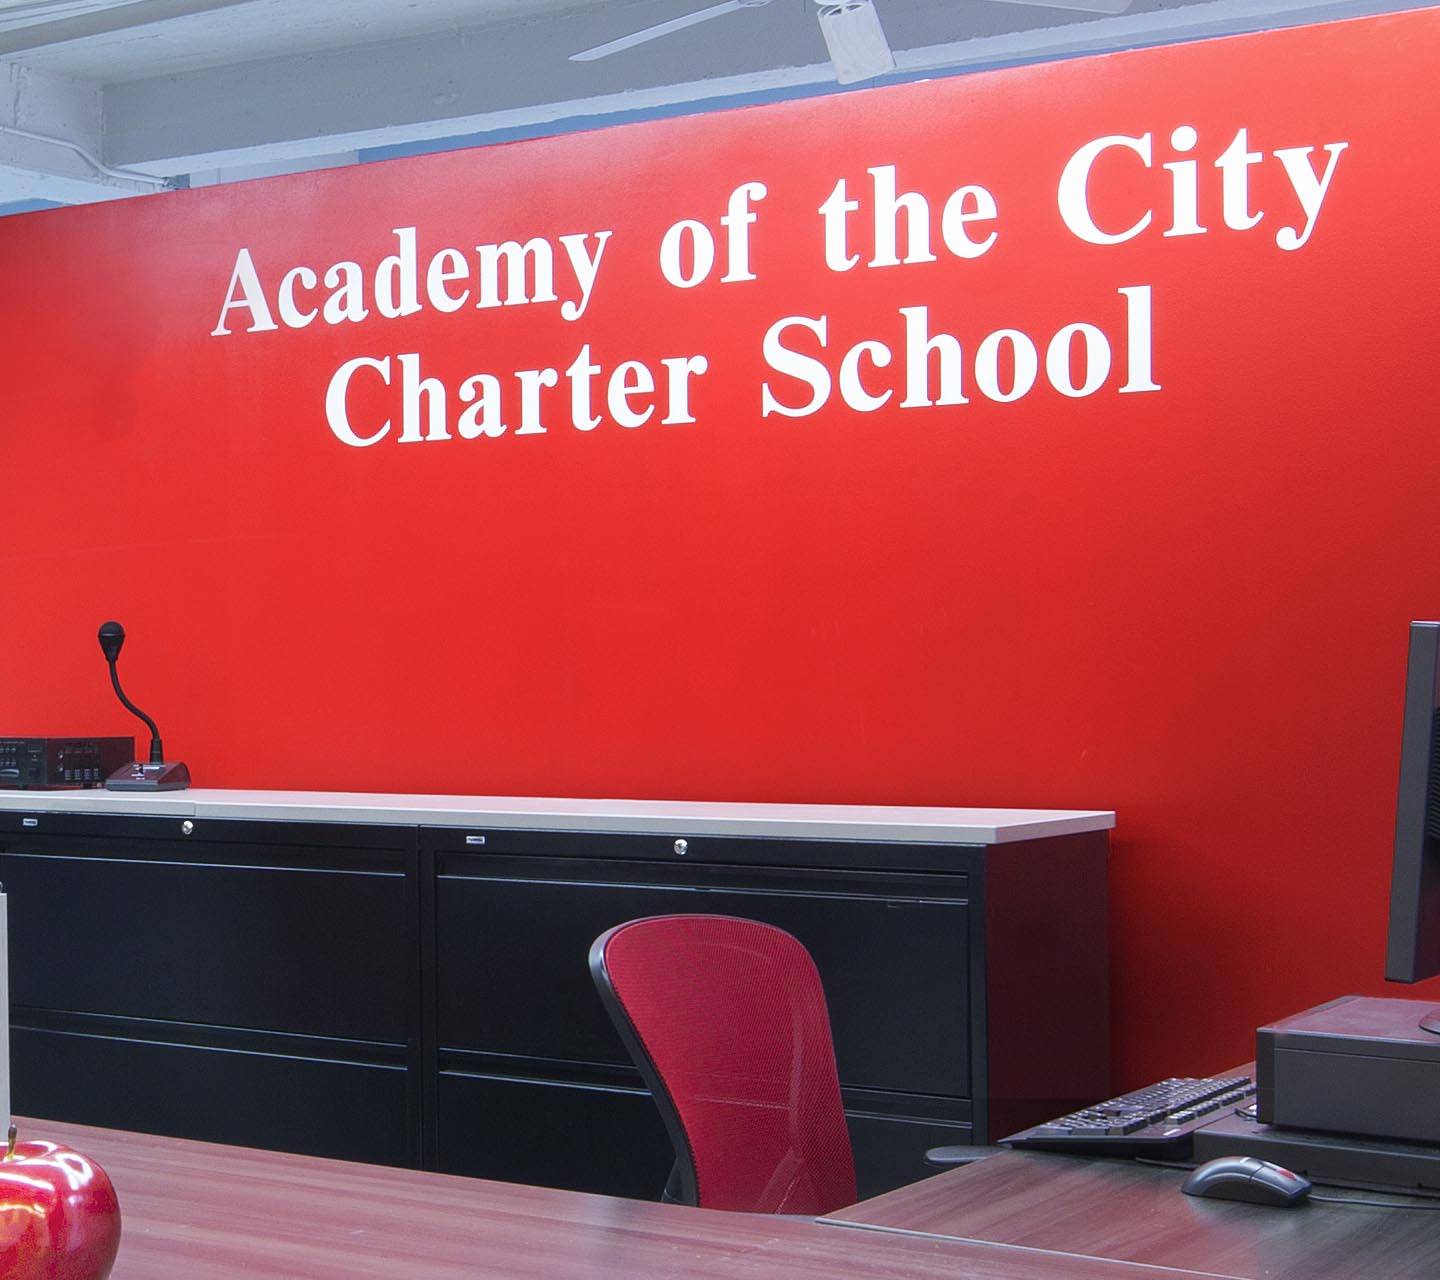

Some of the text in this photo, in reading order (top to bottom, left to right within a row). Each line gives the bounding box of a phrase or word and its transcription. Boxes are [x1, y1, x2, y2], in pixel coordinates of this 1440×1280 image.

[210, 125, 1349, 337] Academy of the City
[325, 285, 1162, 447] Charter School
